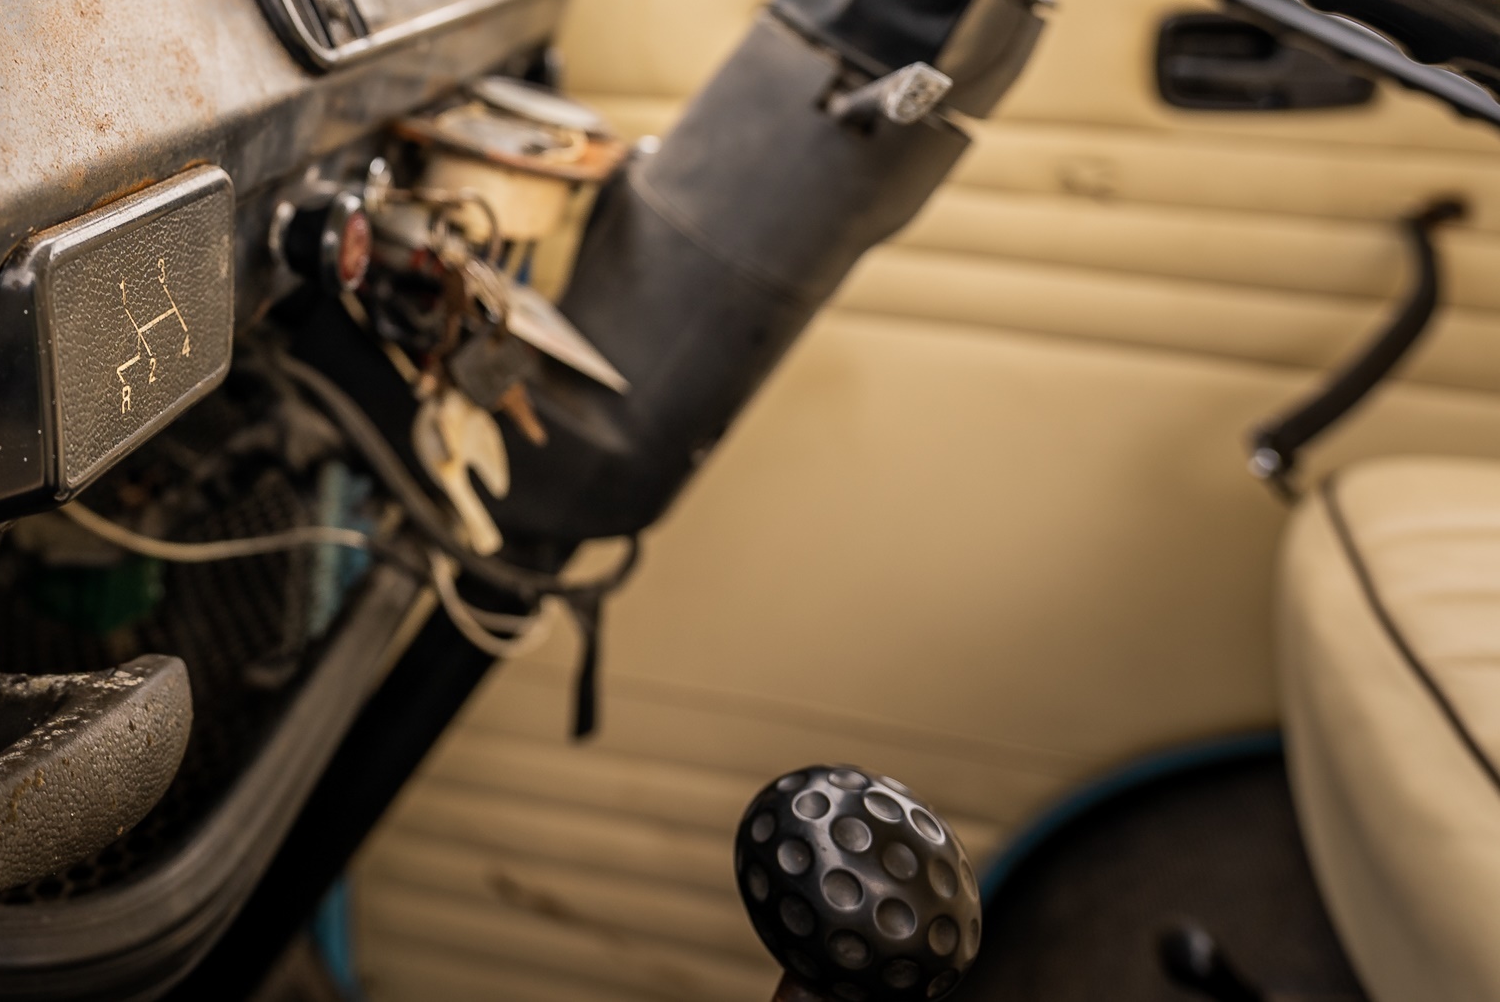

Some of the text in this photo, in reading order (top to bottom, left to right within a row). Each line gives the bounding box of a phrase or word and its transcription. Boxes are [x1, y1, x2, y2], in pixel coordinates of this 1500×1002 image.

[157, 258, 166, 284] 3
[119, 278, 127, 306] 1
[181, 334, 190, 358] 4
[148, 357, 157, 384] 2
[121, 385, 131, 414] R
